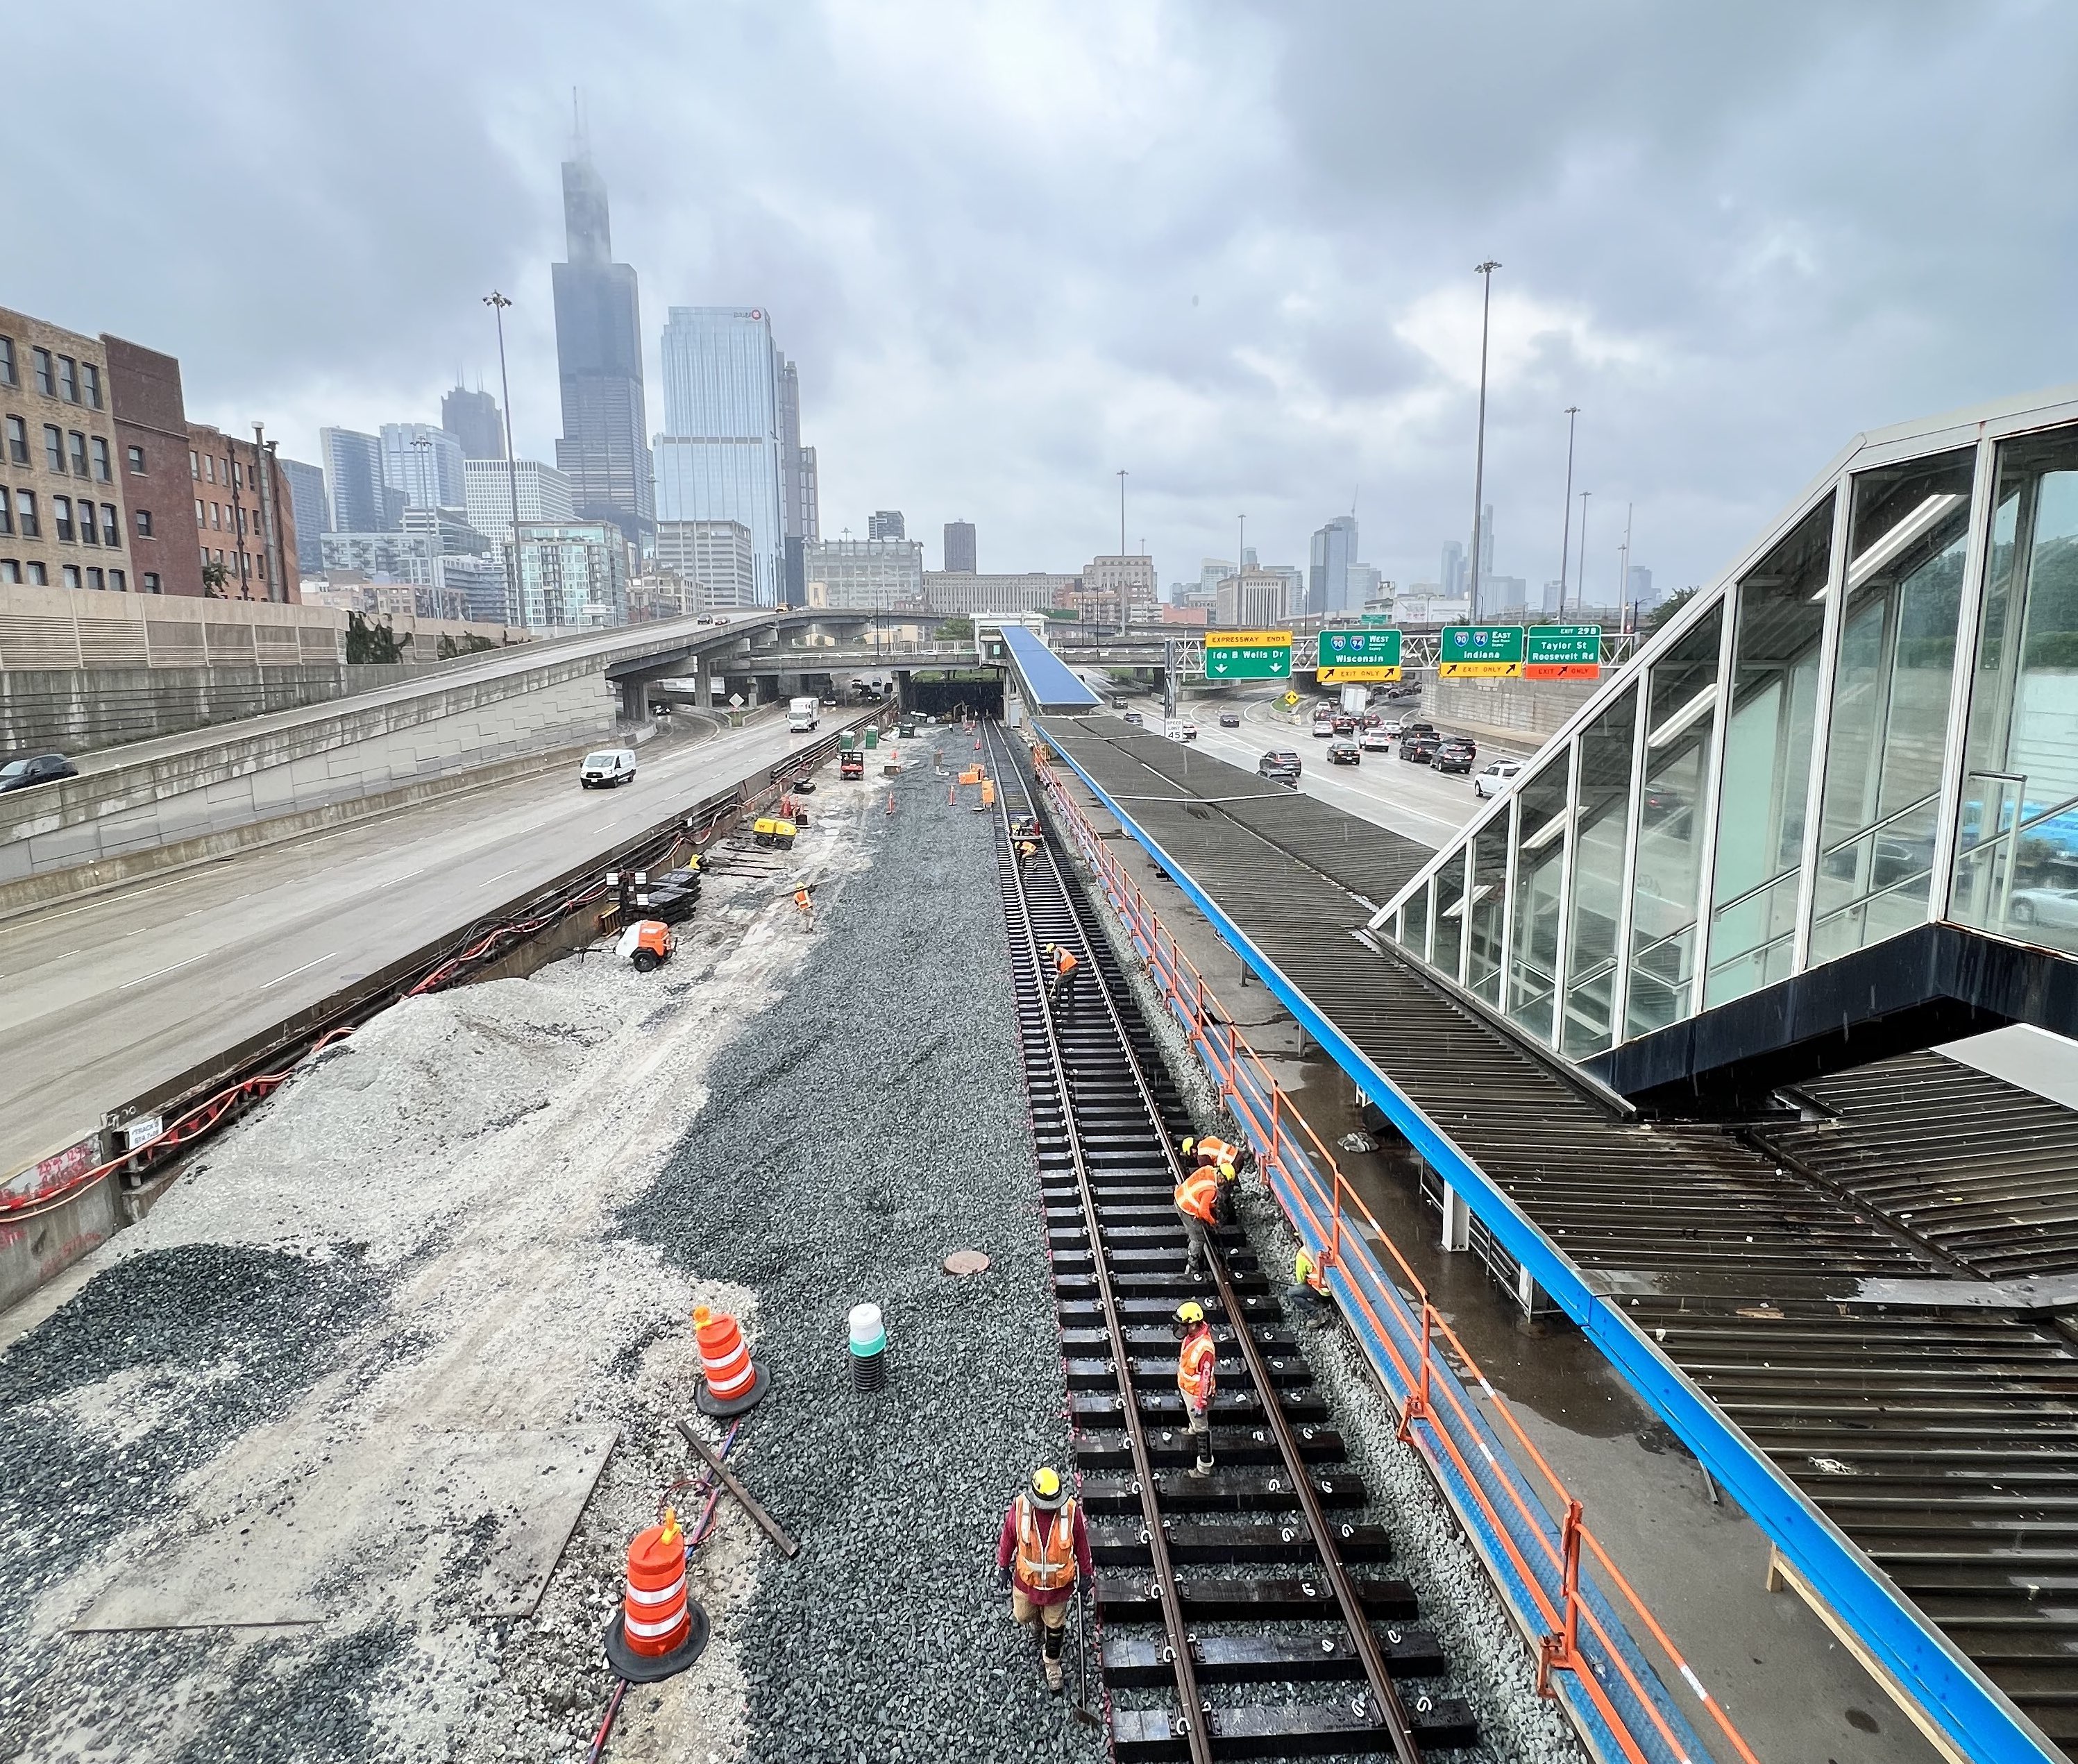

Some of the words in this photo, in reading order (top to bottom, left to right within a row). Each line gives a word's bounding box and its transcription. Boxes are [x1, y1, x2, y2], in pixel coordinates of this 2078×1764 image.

[1492, 631, 1512, 639] EAST
[1541, 641, 1572, 651] Taylor
[1576, 641, 1587, 650] St
[1213, 651, 1228, 659] Ida
[1231, 650, 1238, 659] B
[1242, 650, 1268, 659] Wells
[1272, 650, 1284, 659] Dr
[1335, 654, 1384, 663] Wisconsin
[1464, 650, 1501, 659] Indiana
[1532, 652, 1578, 661] Roosevelt
